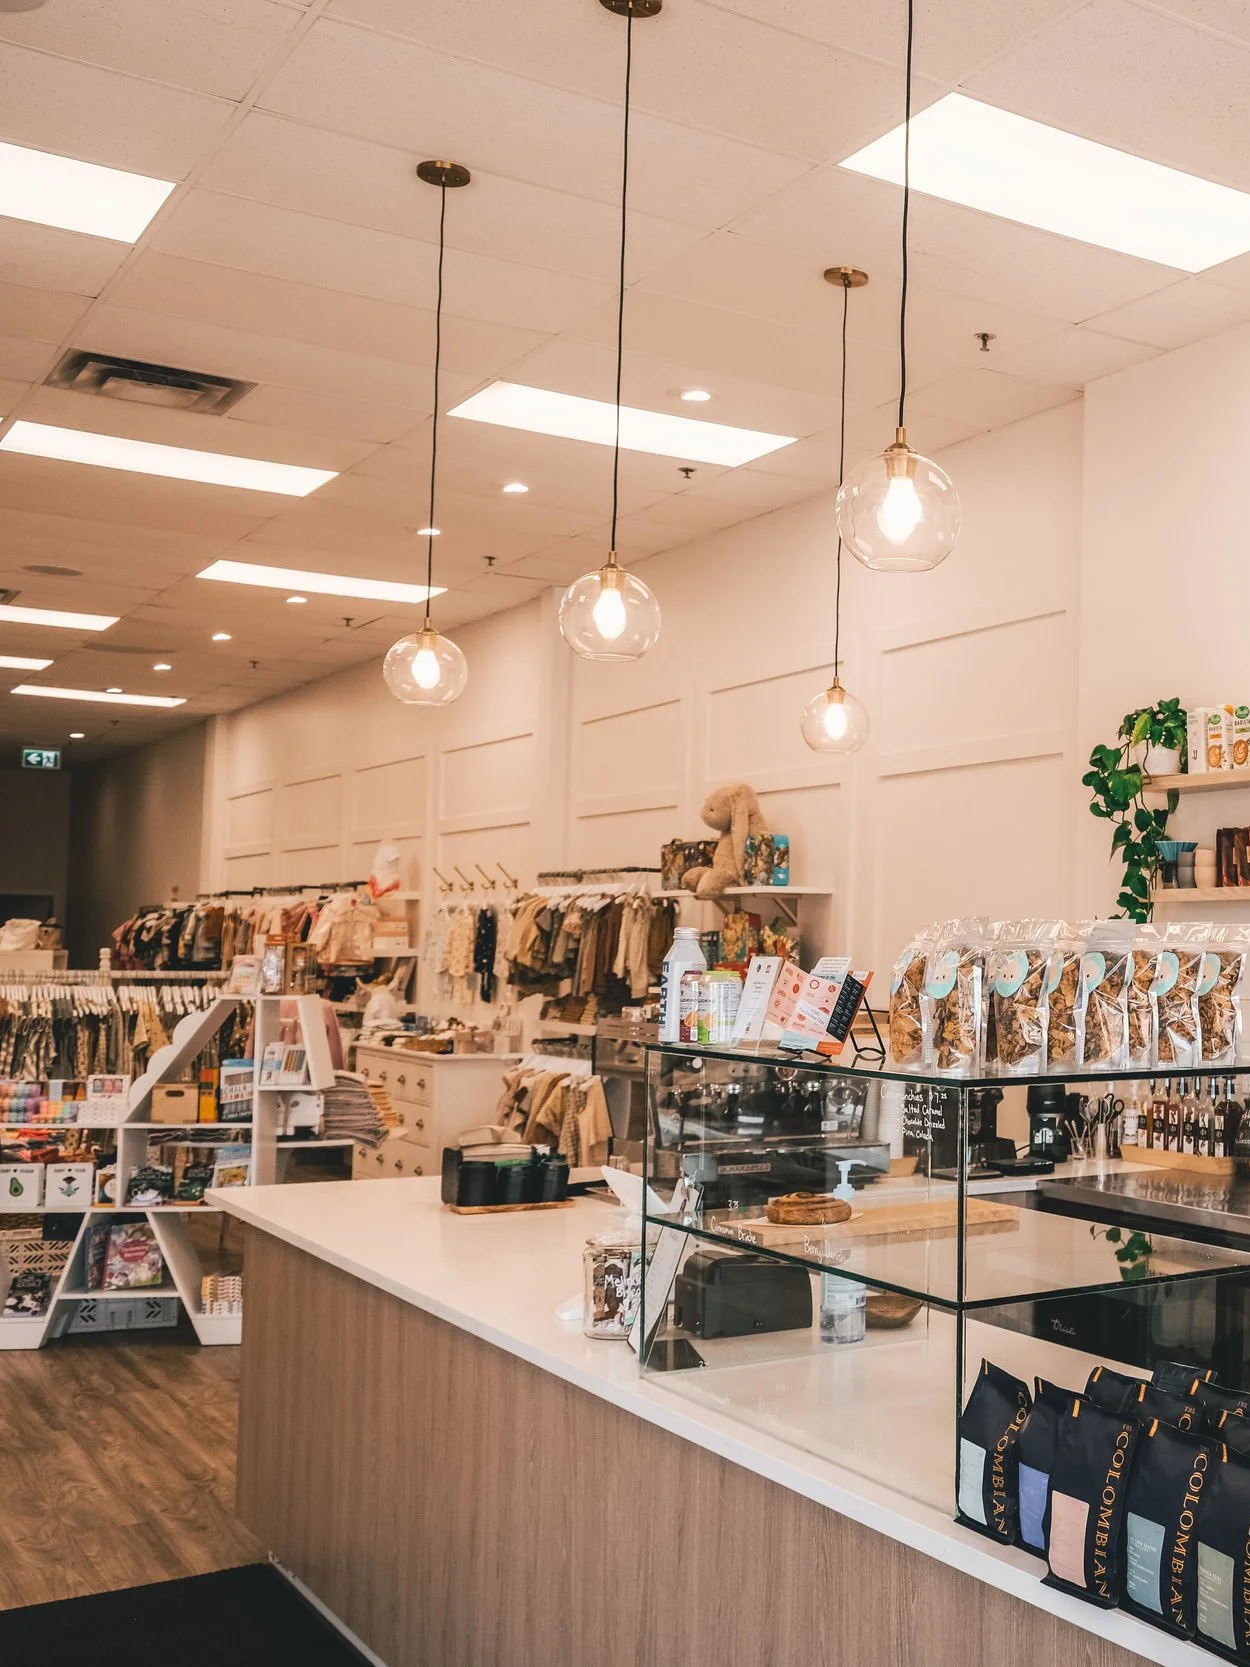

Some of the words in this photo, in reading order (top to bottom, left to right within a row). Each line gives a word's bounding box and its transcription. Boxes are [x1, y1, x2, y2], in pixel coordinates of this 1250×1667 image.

[659, 961, 669, 1025] EARTH
[992, 1391, 1028, 1536] COLOMBIAN
[1094, 1431, 1130, 1600] COLOMBIAN
[1171, 1453, 1209, 1630] COLOMBIAN
